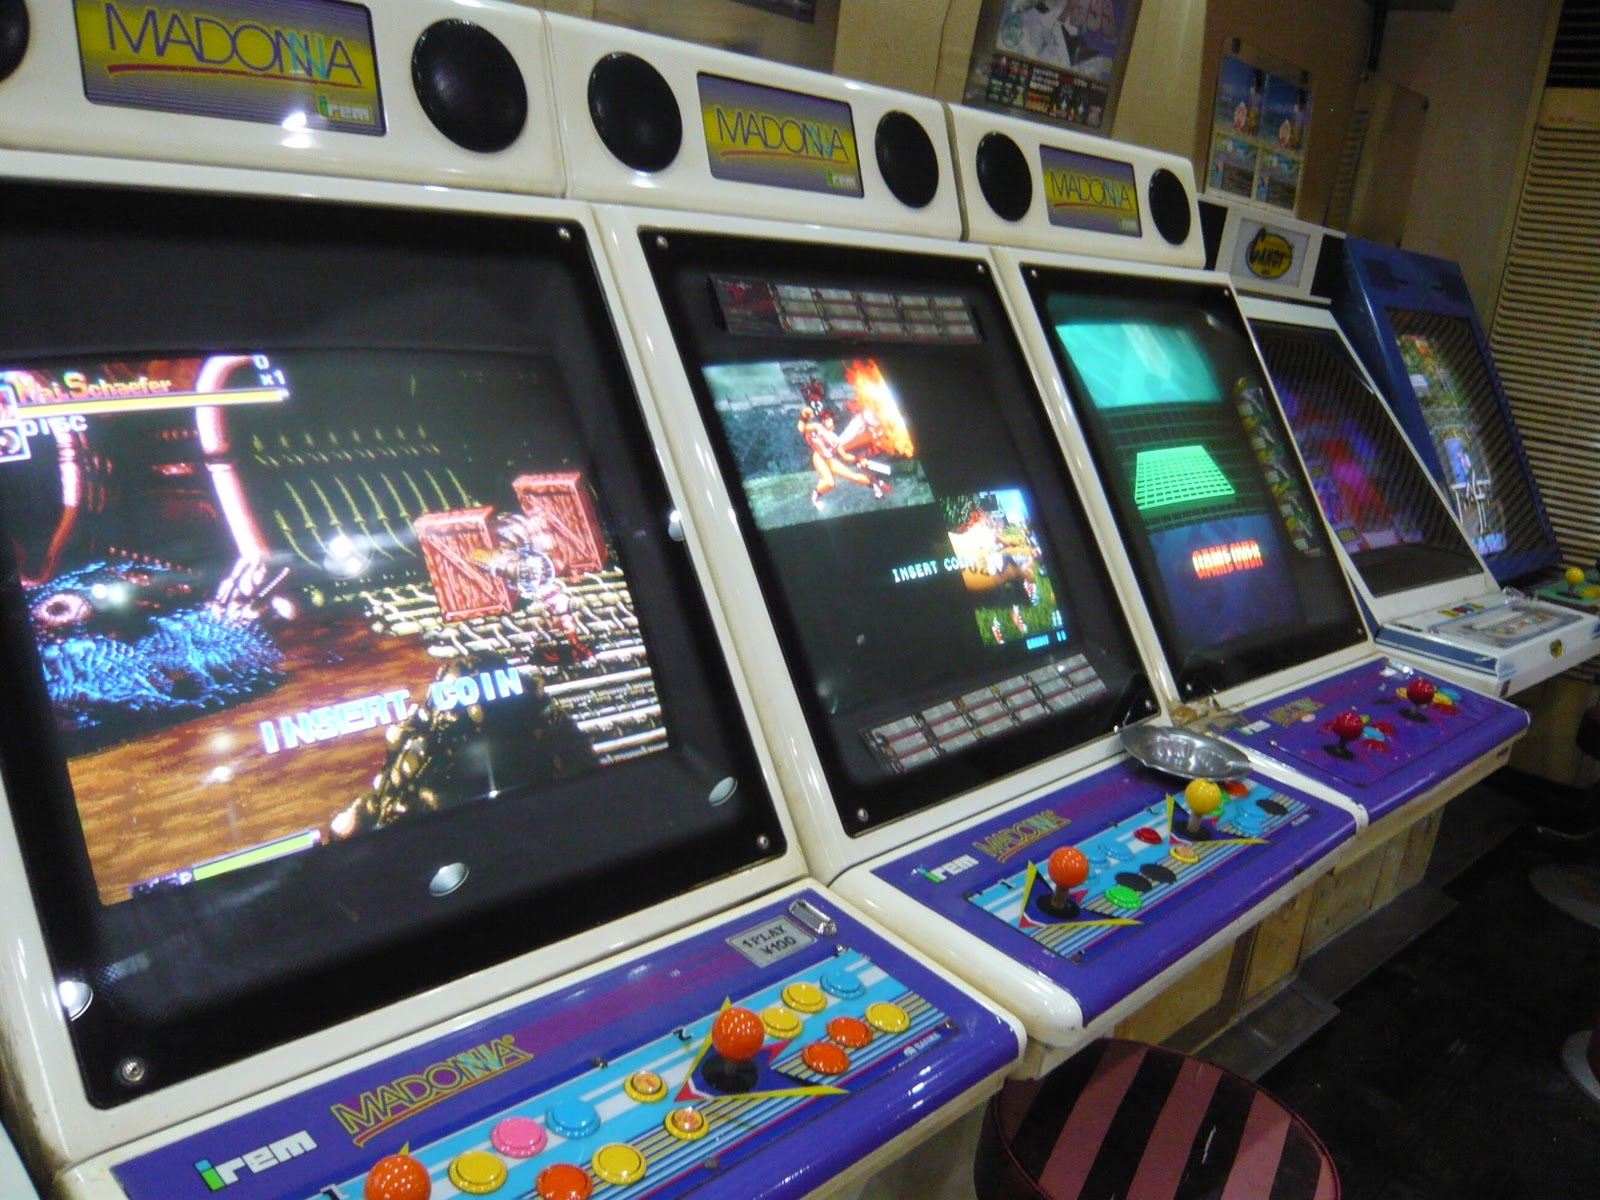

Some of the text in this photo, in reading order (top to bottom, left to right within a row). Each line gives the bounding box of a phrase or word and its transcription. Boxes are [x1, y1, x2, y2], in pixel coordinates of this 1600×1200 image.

[105, 3, 362, 84] MADONNA
[318, 95, 370, 121] irem
[716, 107, 850, 160] MADONNA
[1050, 169, 1133, 208] MADONNA
[892, 559, 940, 583] INSERT
[259, 667, 523, 754] INSERT COIN
[916, 853, 979, 884] irem
[194, 1037, 529, 1191] irem MADONNA
